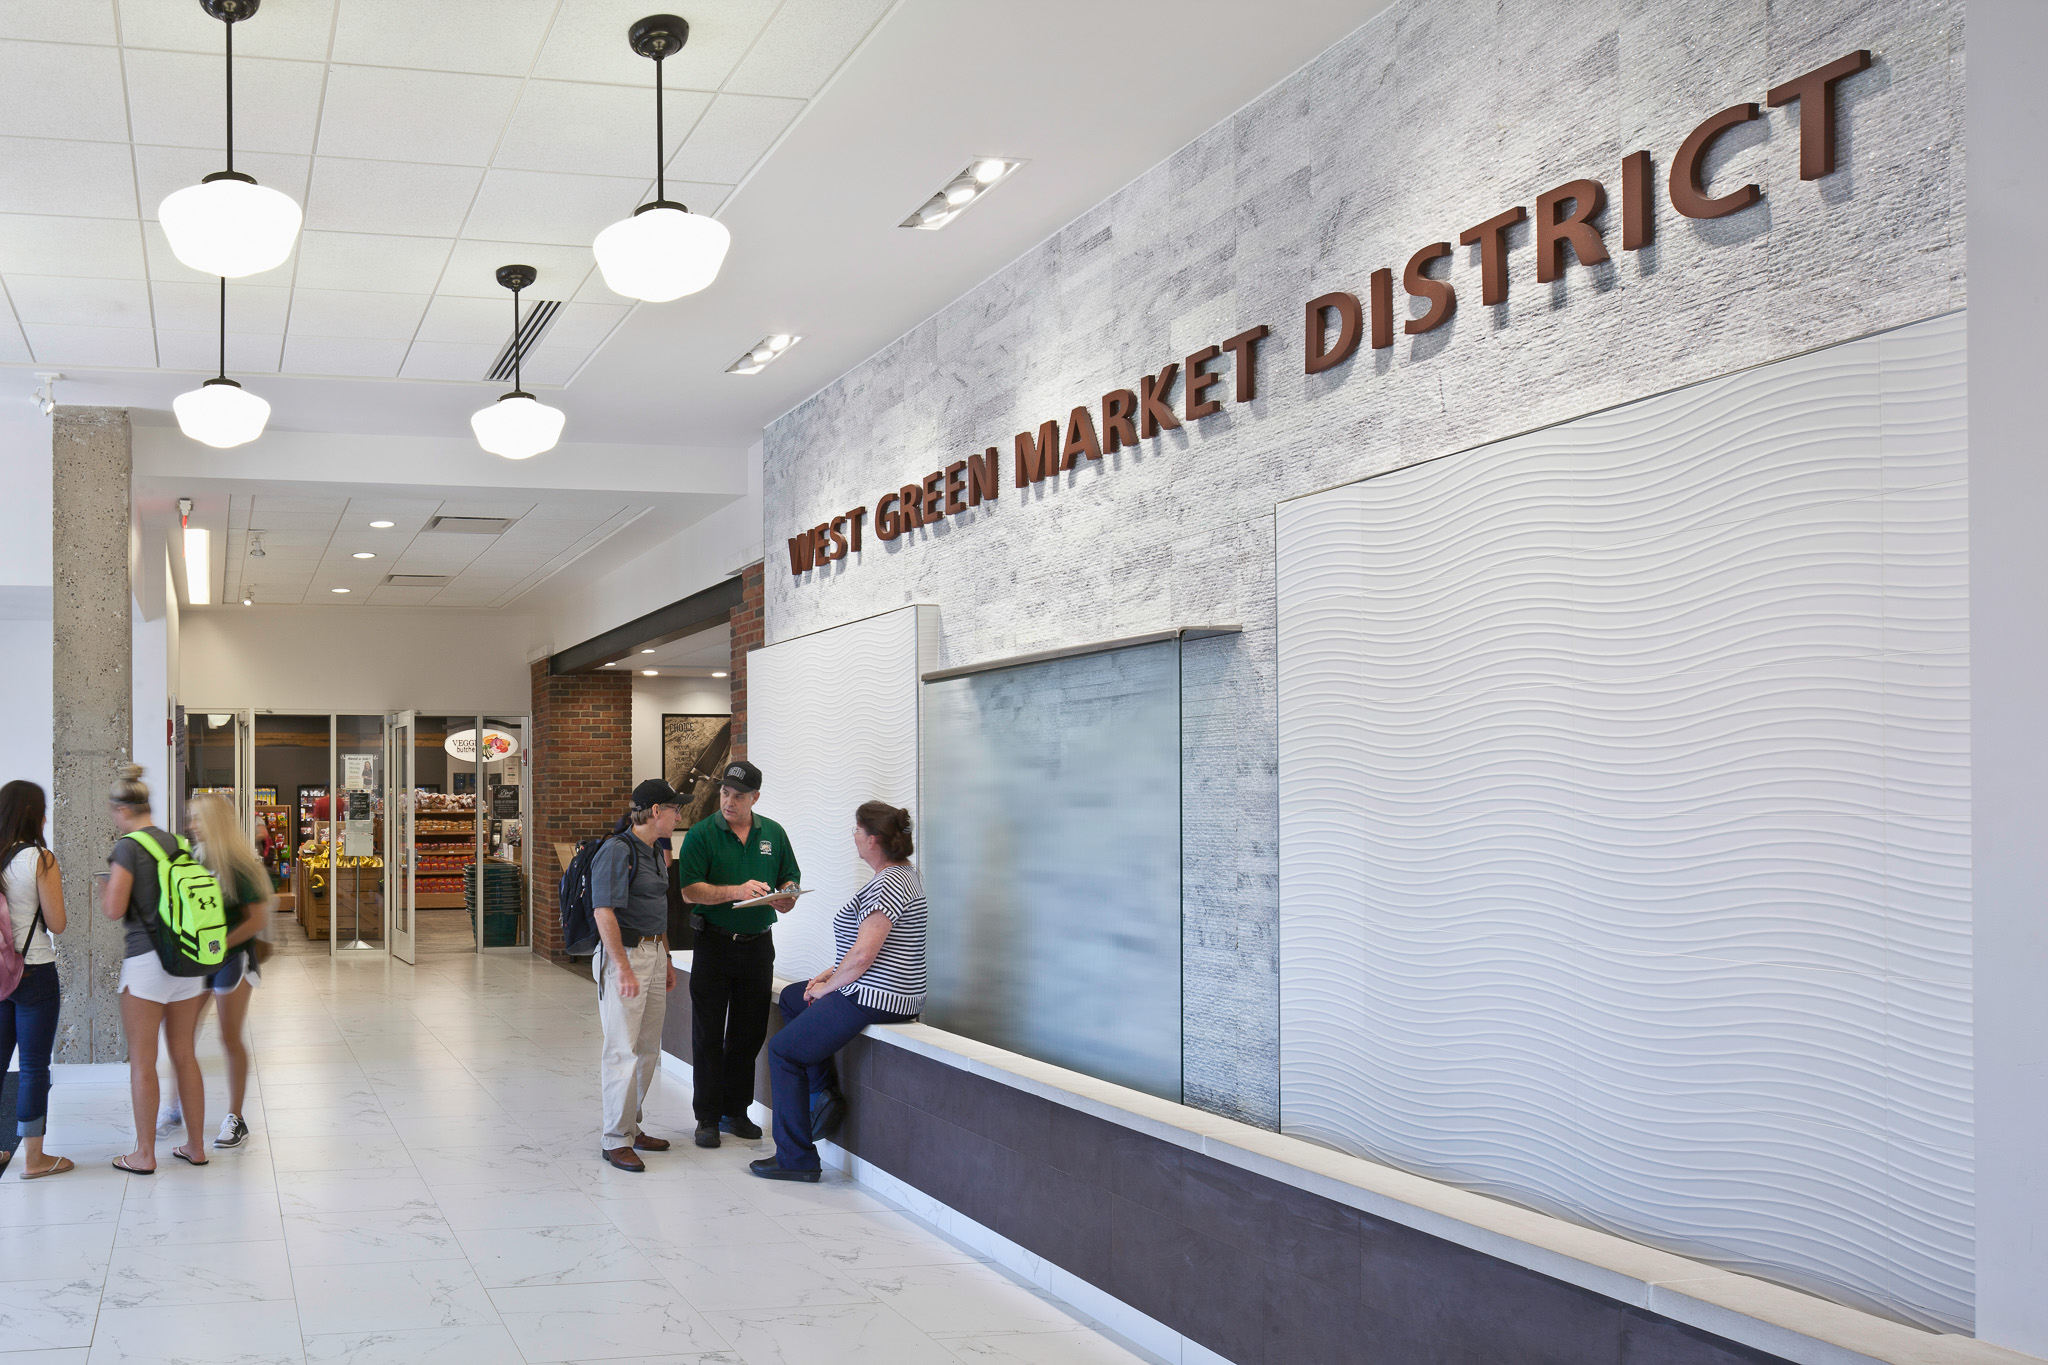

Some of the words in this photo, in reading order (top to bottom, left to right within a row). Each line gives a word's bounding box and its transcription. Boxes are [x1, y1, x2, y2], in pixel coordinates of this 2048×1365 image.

[788, 506, 866, 575] WEST
[875, 446, 999, 542] GREEN
[1014, 324, 1269, 489] MARKET
[1304, 49, 1871, 375] DISTRICT
[669, 722, 695, 733] CHOICE
[452, 739, 477, 747] VEGGI
[456, 745, 476, 753] butche
